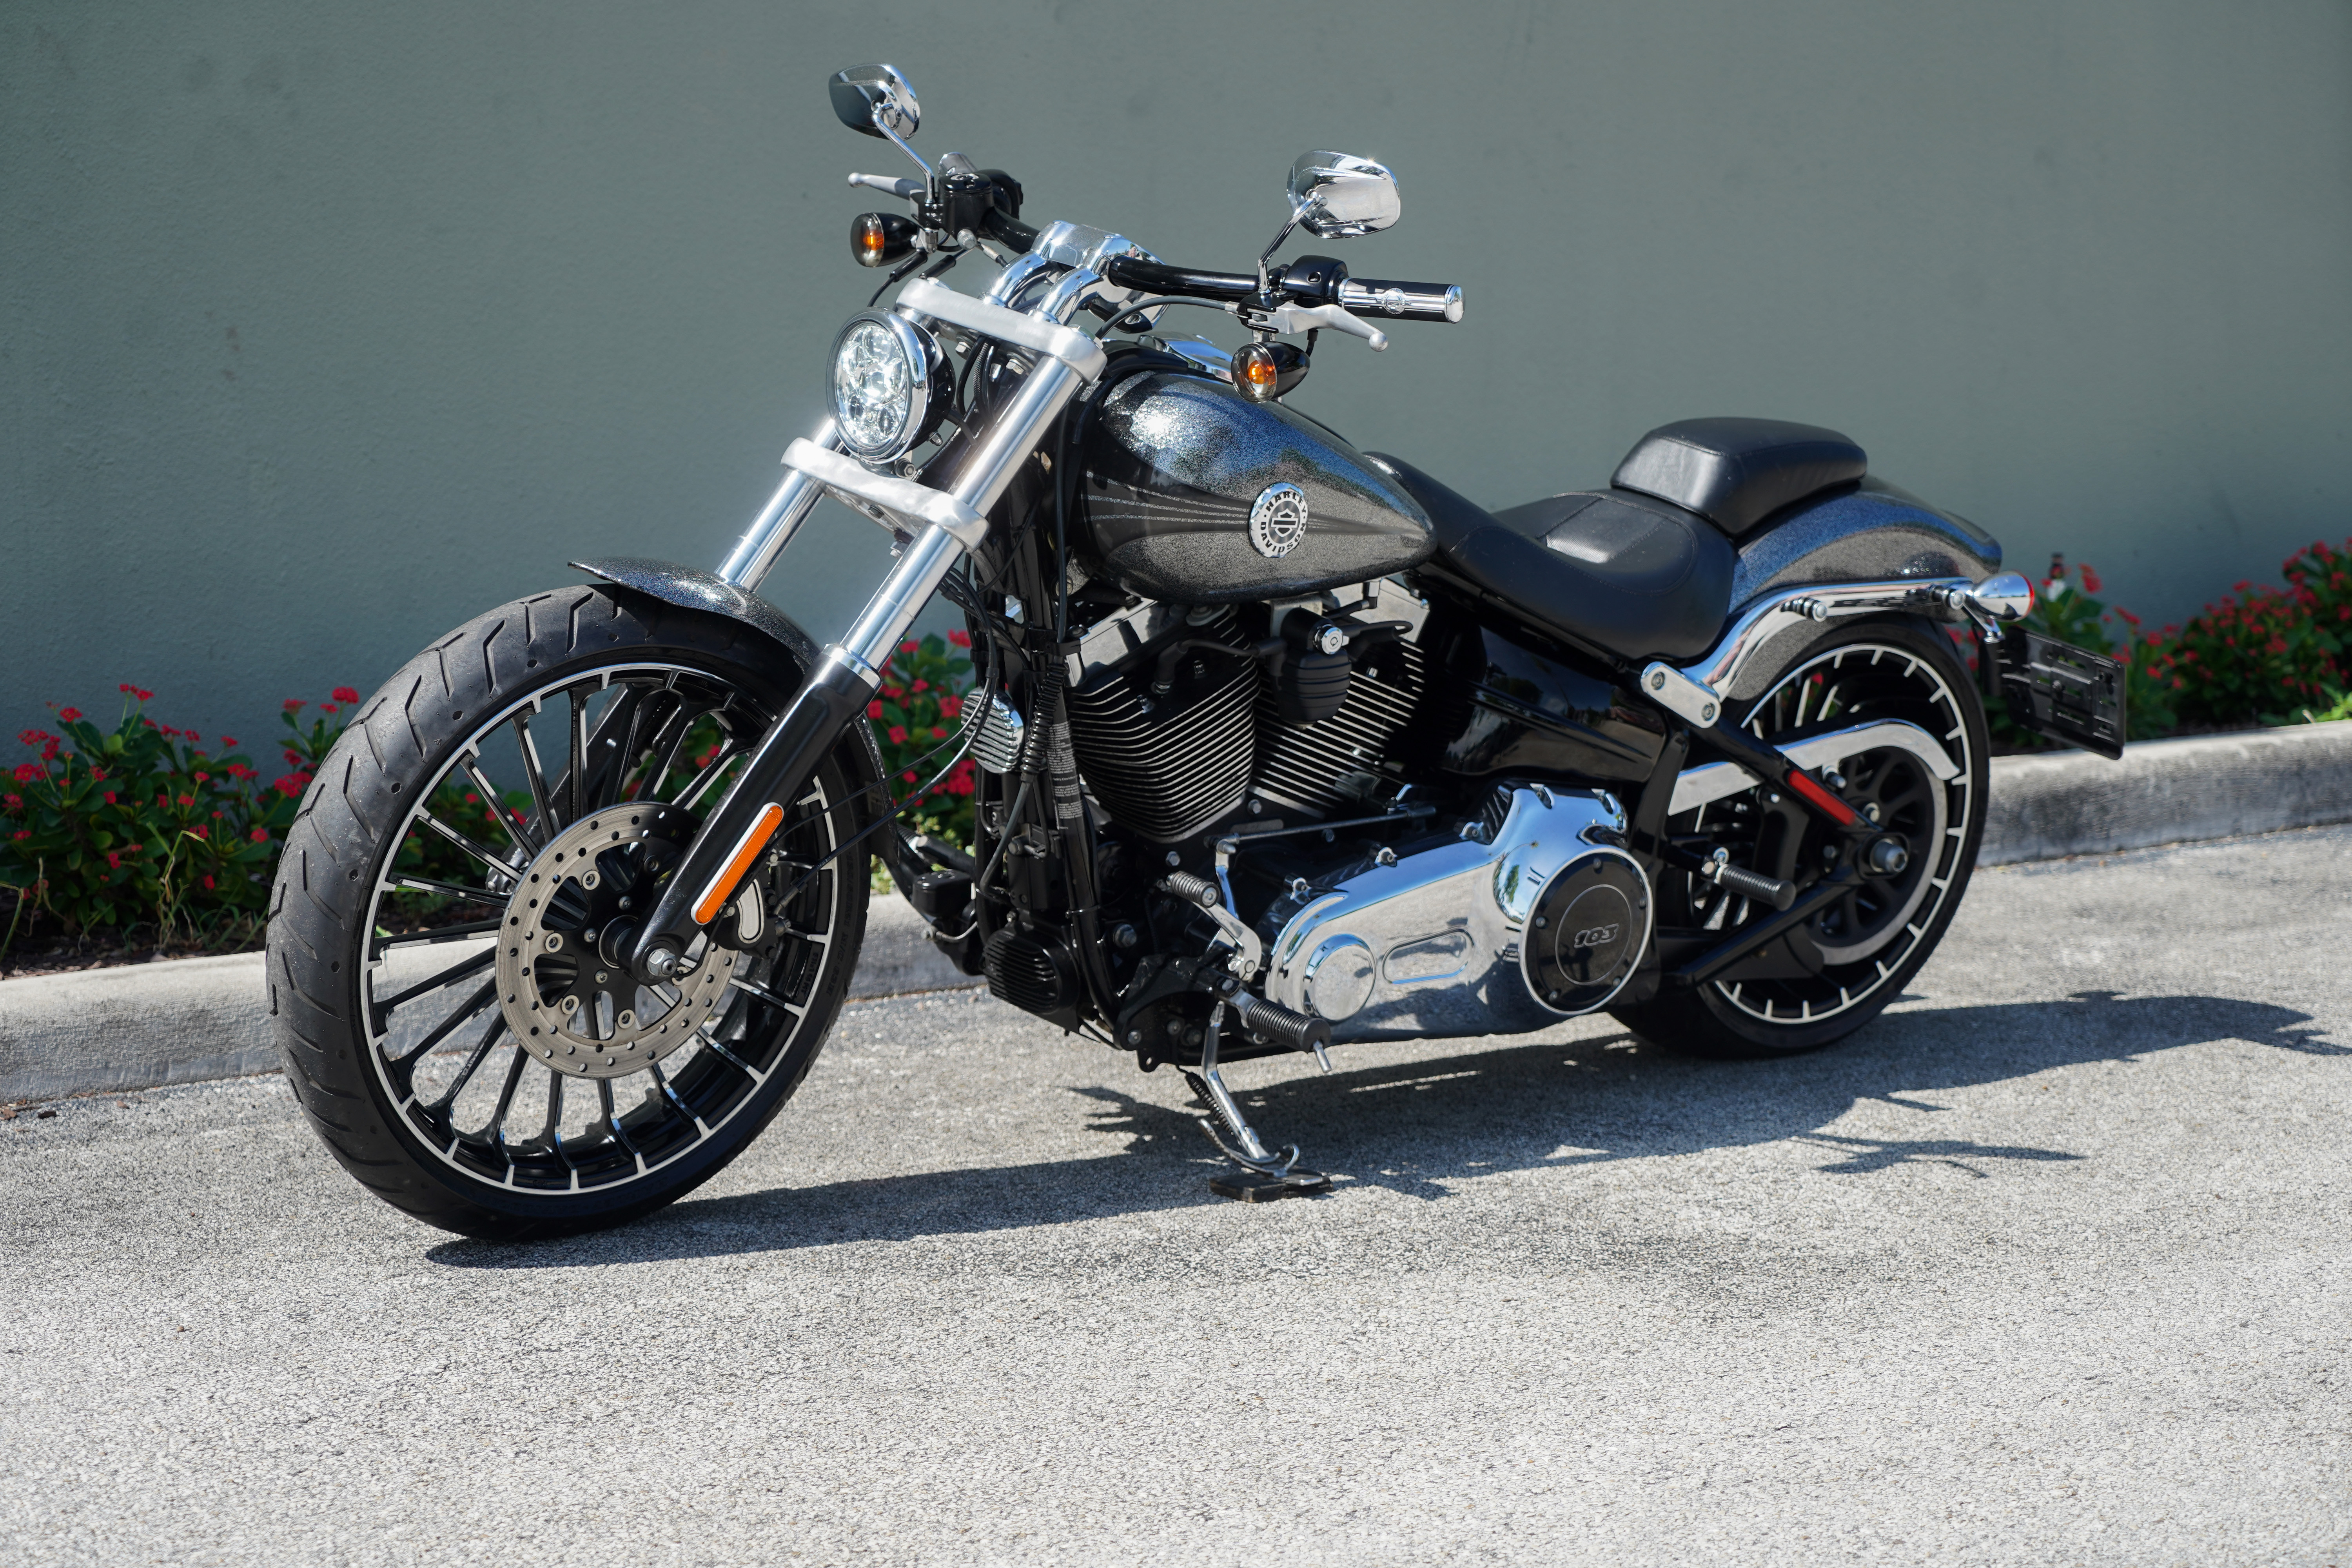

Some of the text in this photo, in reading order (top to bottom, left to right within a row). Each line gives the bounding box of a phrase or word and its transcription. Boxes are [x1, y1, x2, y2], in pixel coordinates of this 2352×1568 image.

[1265, 491, 1307, 512] HARLEY
[1260, 521, 1305, 553] DAVIDSON
[1574, 923, 1619, 948] 103
